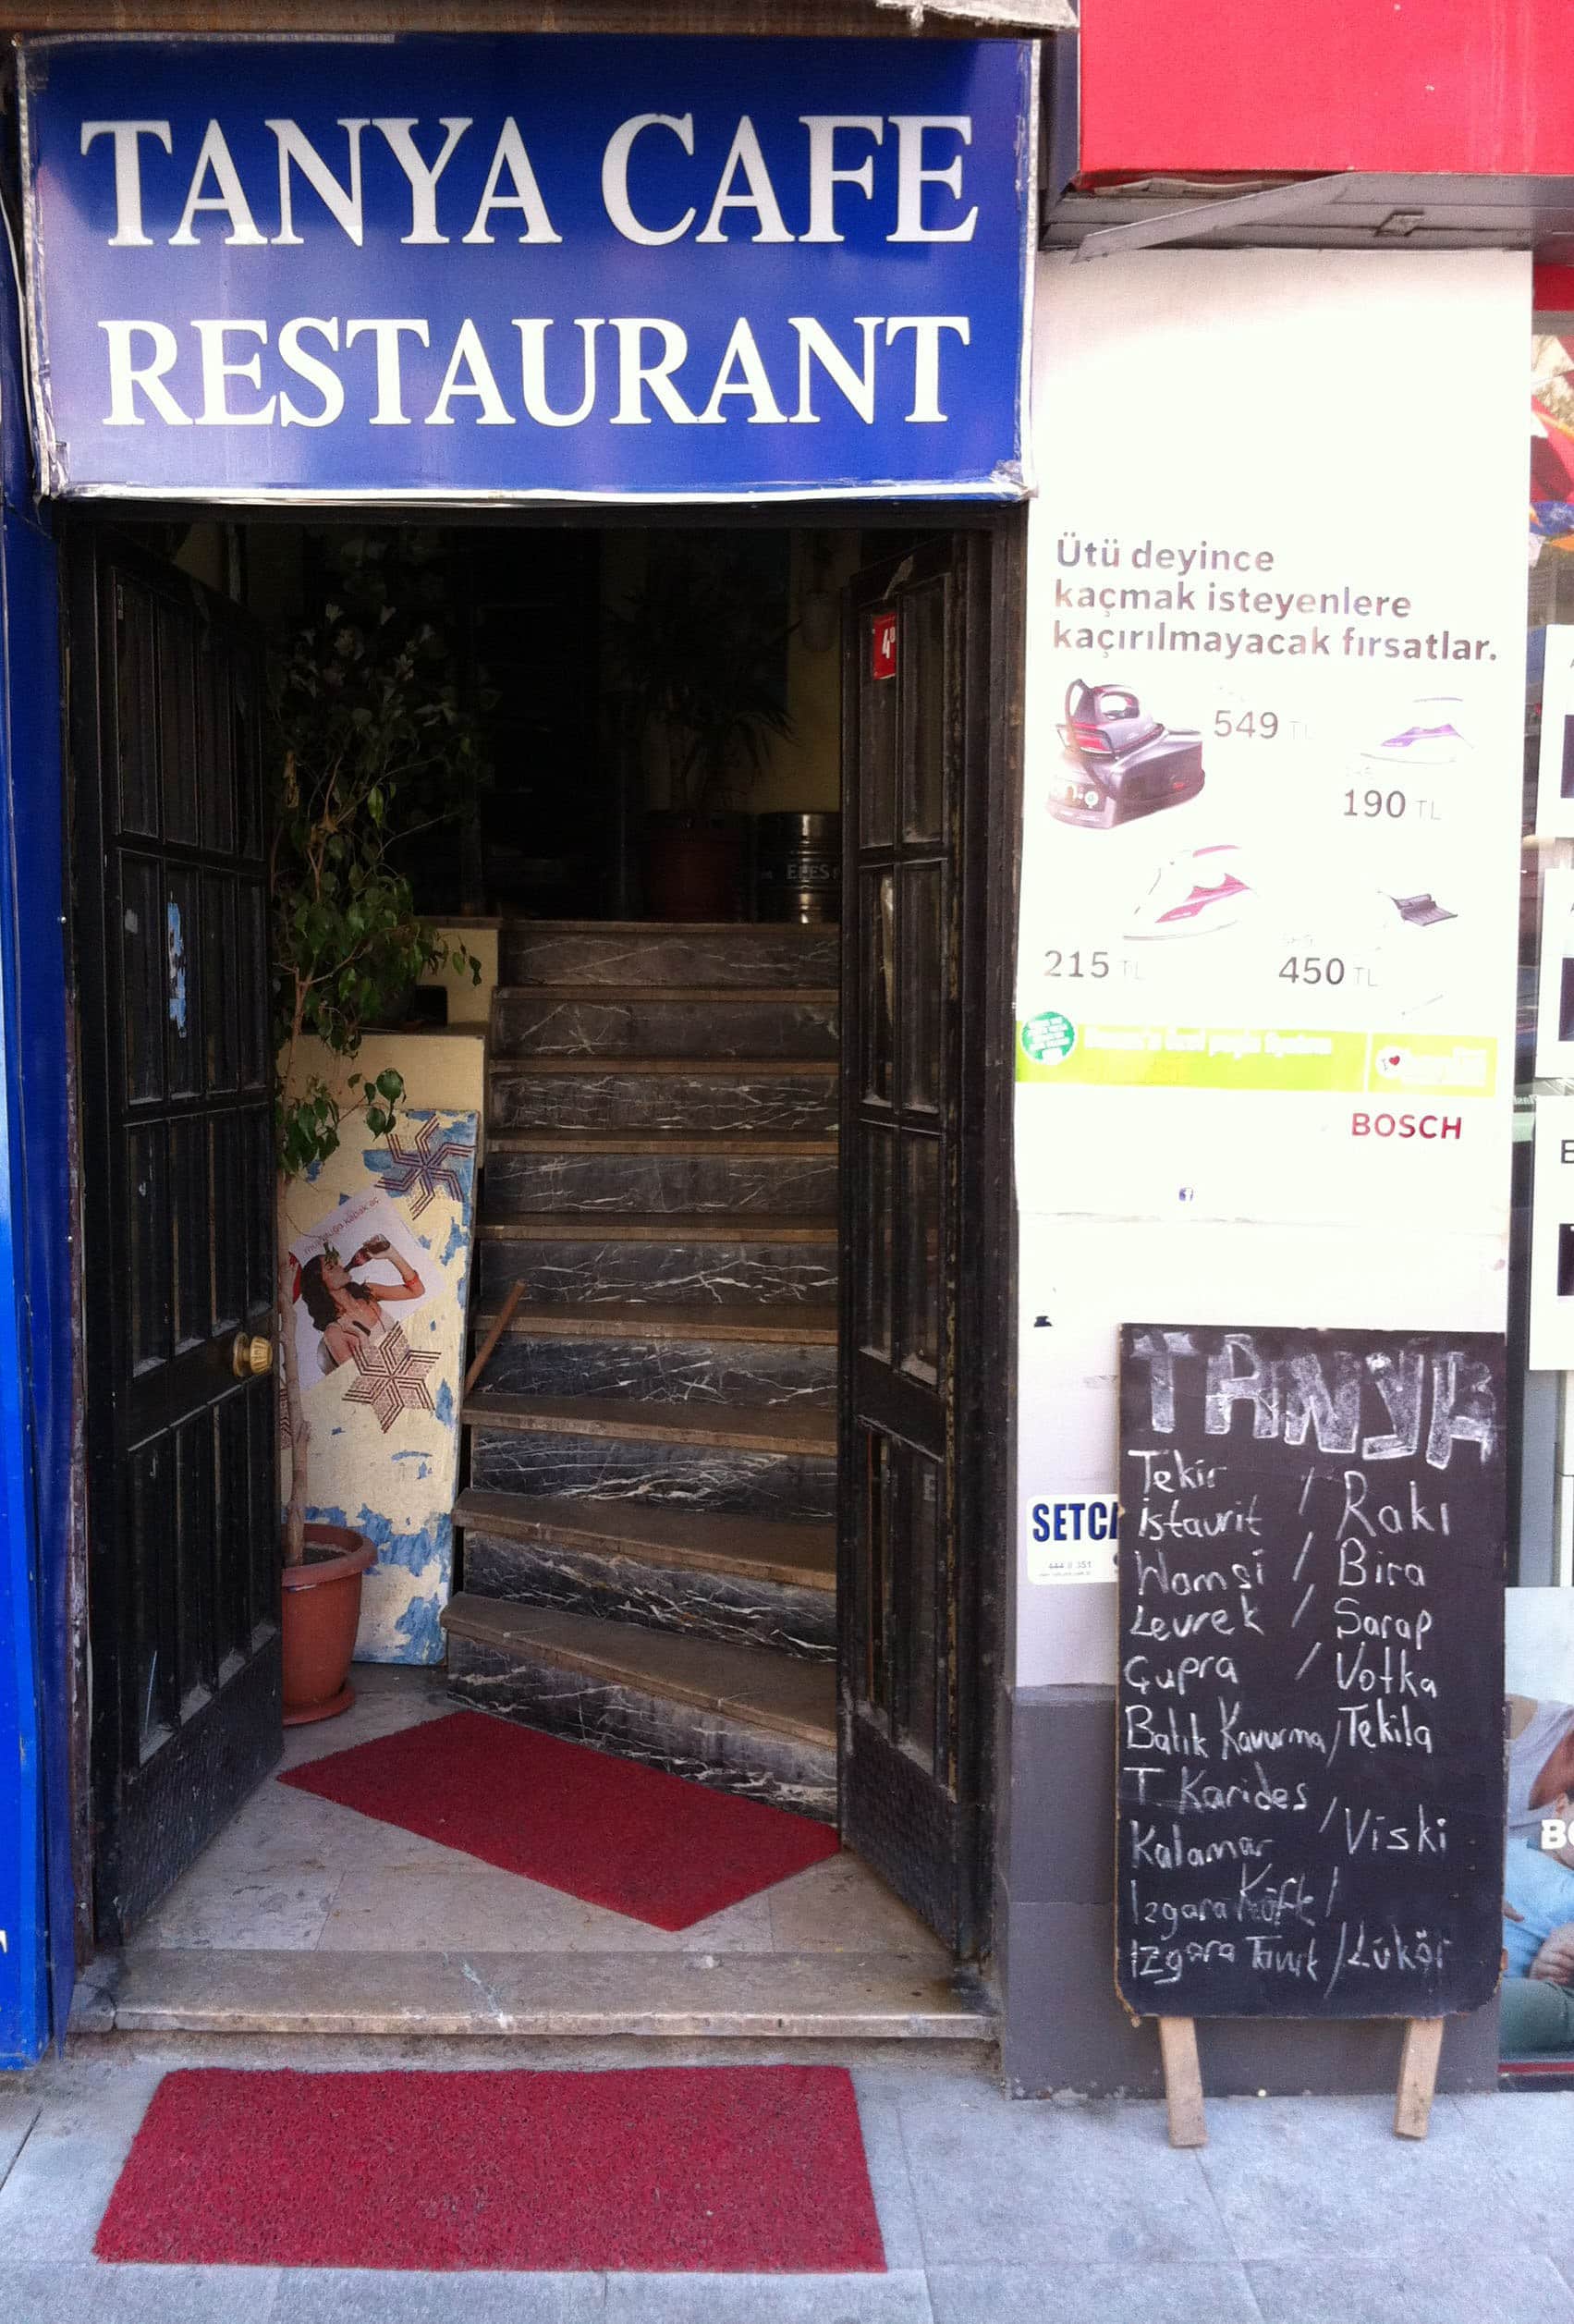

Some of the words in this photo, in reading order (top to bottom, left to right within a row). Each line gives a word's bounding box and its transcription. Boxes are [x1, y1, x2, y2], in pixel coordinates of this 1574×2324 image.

[80, 117, 563, 247] TANYA
[602, 112, 979, 247] CAFE
[97, 316, 970, 428] RESTAURANT
[1055, 532, 1121, 569] Ütü
[1132, 539, 1275, 576] deyince
[1055, 580, 1195, 618] kaçmak
[1208, 584, 1412, 620] isteyenlere
[1053, 620, 1331, 659] kaçırılmayacak
[1342, 628, 1497, 661] fırsatlar.
[1214, 709, 1279, 740] 549
[1343, 789, 1406, 819] 190
[1415, 800, 1443, 821] TL
[1043, 949, 1110, 979] 215
[1278, 956, 1346, 985] 450
[1352, 966, 1381, 988] TL
[1351, 1112, 1462, 1140] BOSCH
[1129, 1331, 1497, 1471] TANYA
[1127, 1449, 1228, 1494] Tekir
[1338, 1536, 1425, 1586] Bira
[1129, 1592, 1265, 1642] Levrek
[1336, 1641, 1438, 1698] Votka
[1338, 1697, 1434, 1755] Tekila
[1123, 1767, 1165, 1805] T
[1177, 1760, 1309, 1815] Karides
[1129, 1819, 1275, 1869] Kalamar
[1345, 1804, 1447, 1854] Viski
